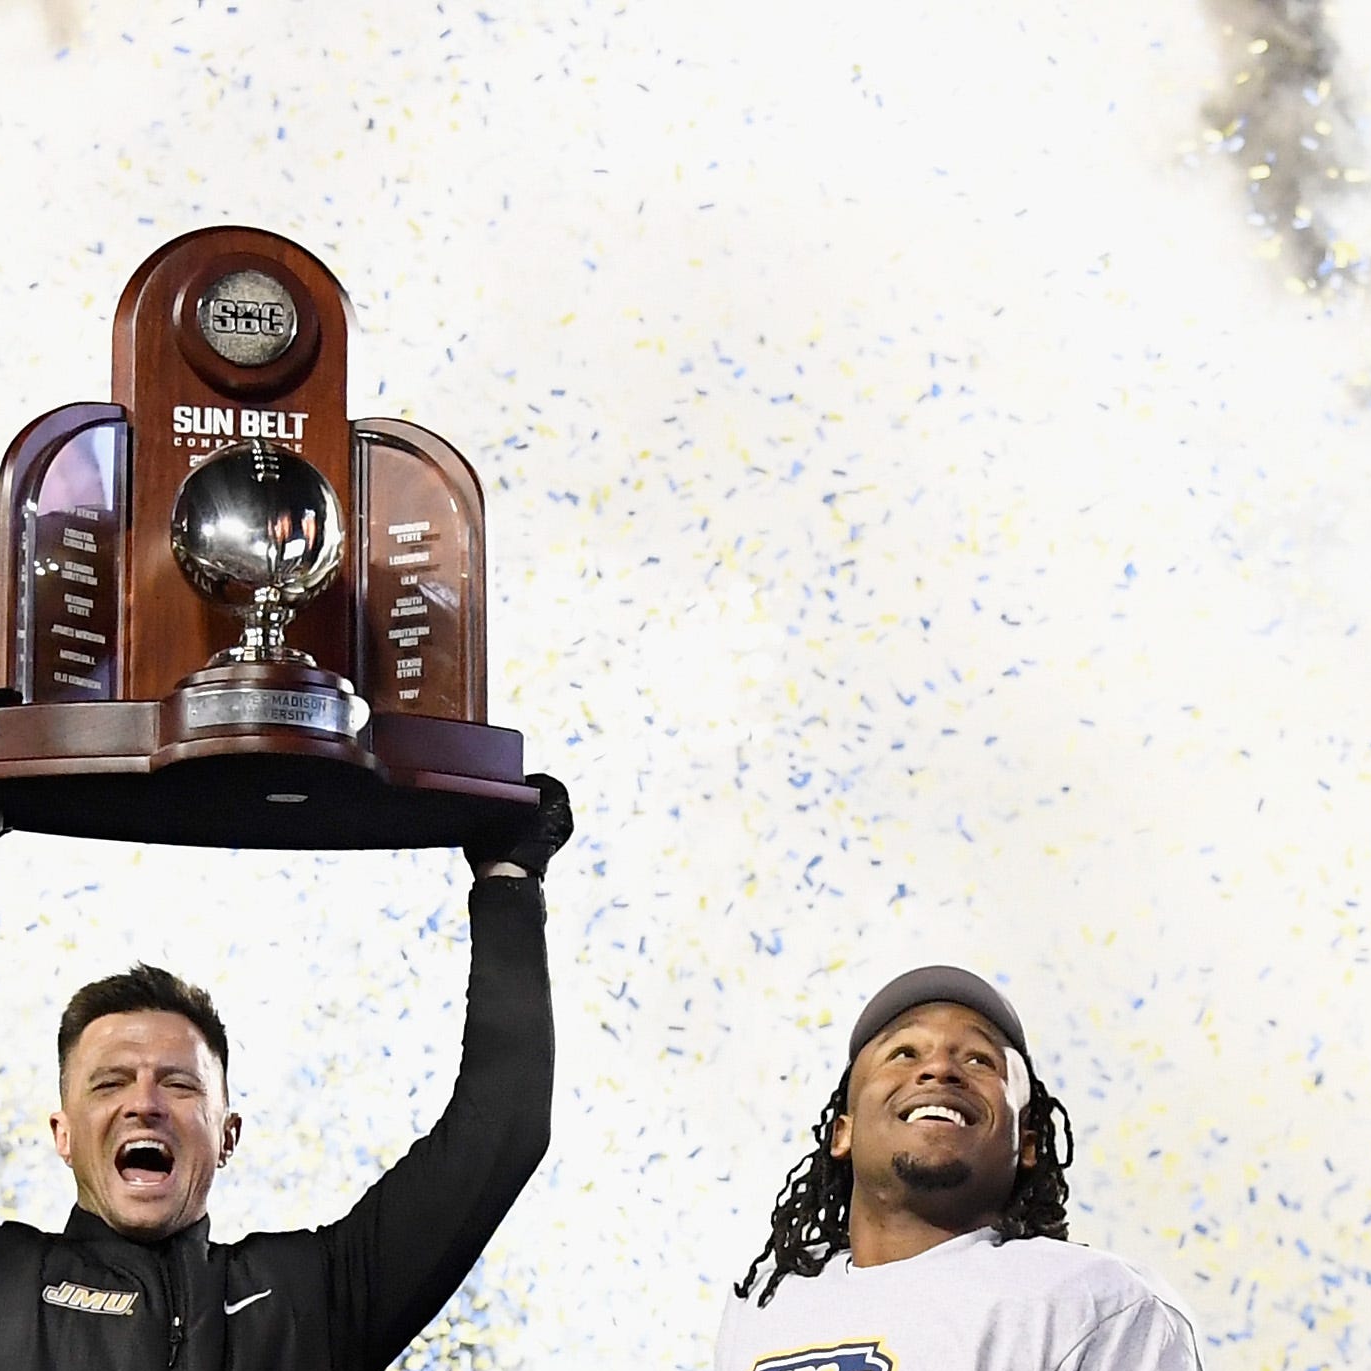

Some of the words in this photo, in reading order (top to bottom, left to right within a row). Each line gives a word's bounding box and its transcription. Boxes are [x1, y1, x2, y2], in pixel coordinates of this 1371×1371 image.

[213, 299, 284, 336] SBC
[173, 405, 234, 436] SUN
[240, 409, 309, 440] BELT
[173, 437, 302, 453] CONFE
[271, 694, 327, 712] MADISON
[42, 1281, 138, 1315] JMU
